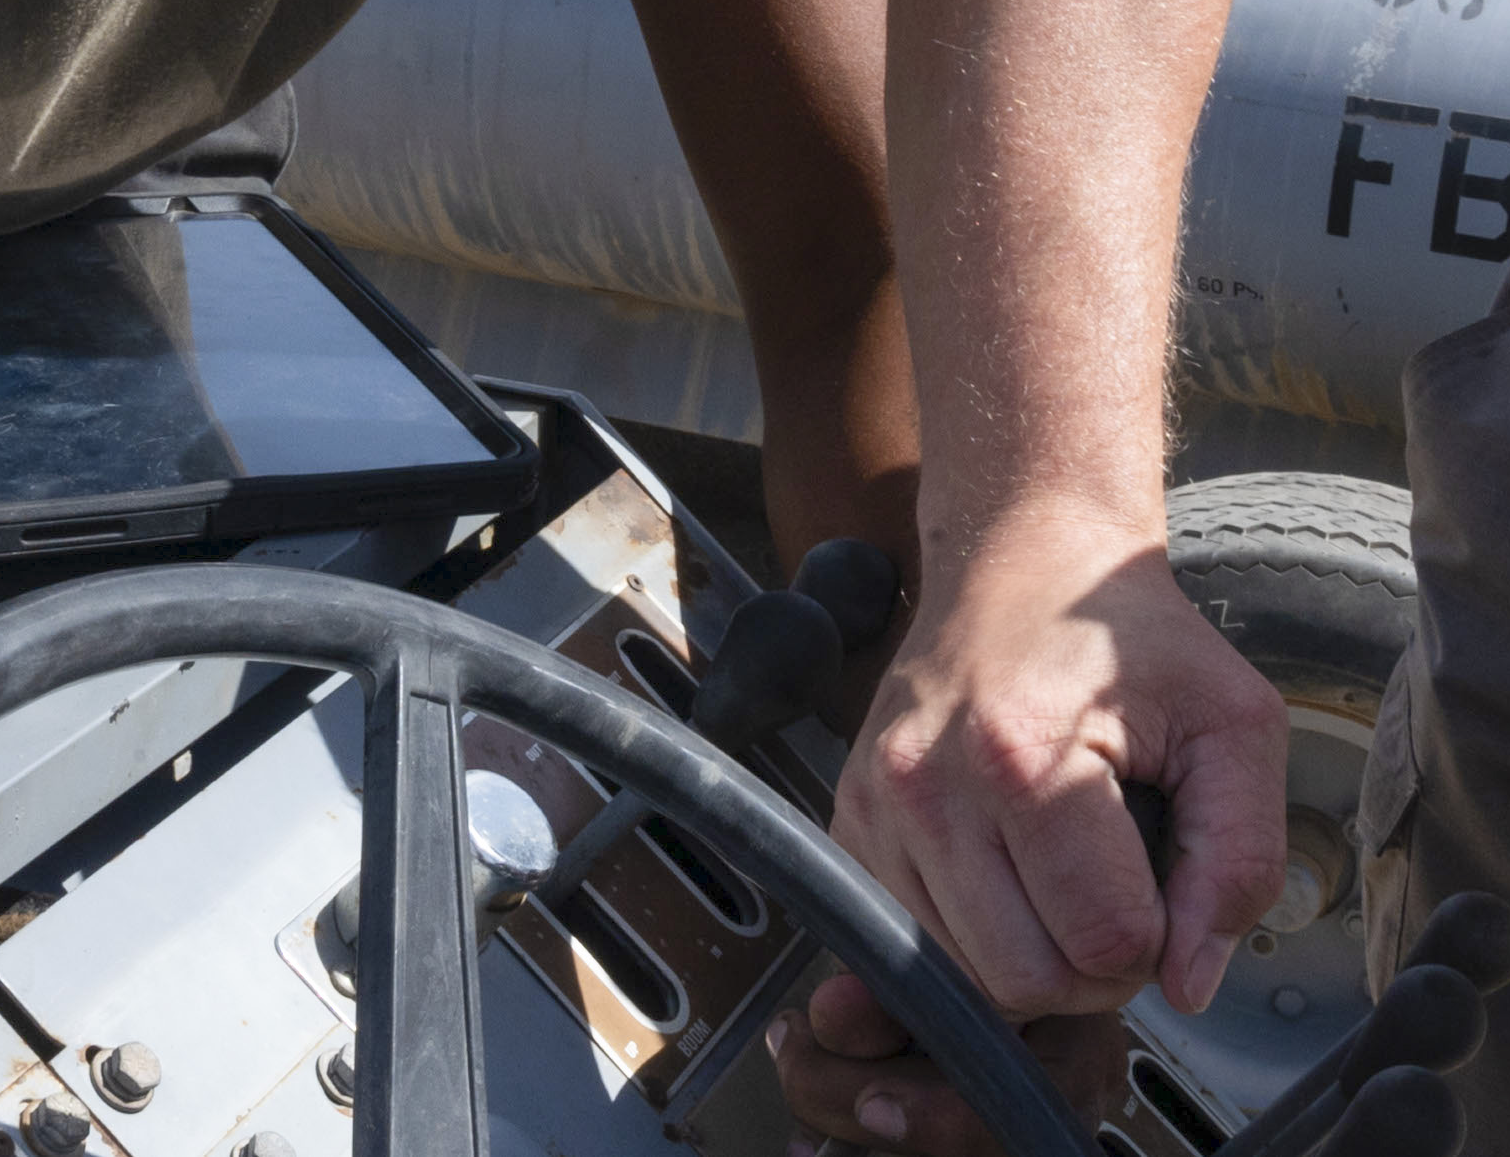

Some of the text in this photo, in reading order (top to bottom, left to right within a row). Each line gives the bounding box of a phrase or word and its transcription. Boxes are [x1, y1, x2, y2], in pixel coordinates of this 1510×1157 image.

[1197, 276, 1224, 295] 60
[677, 1020, 713, 1058] BOOM
[624, 1040, 639, 1058] UP
